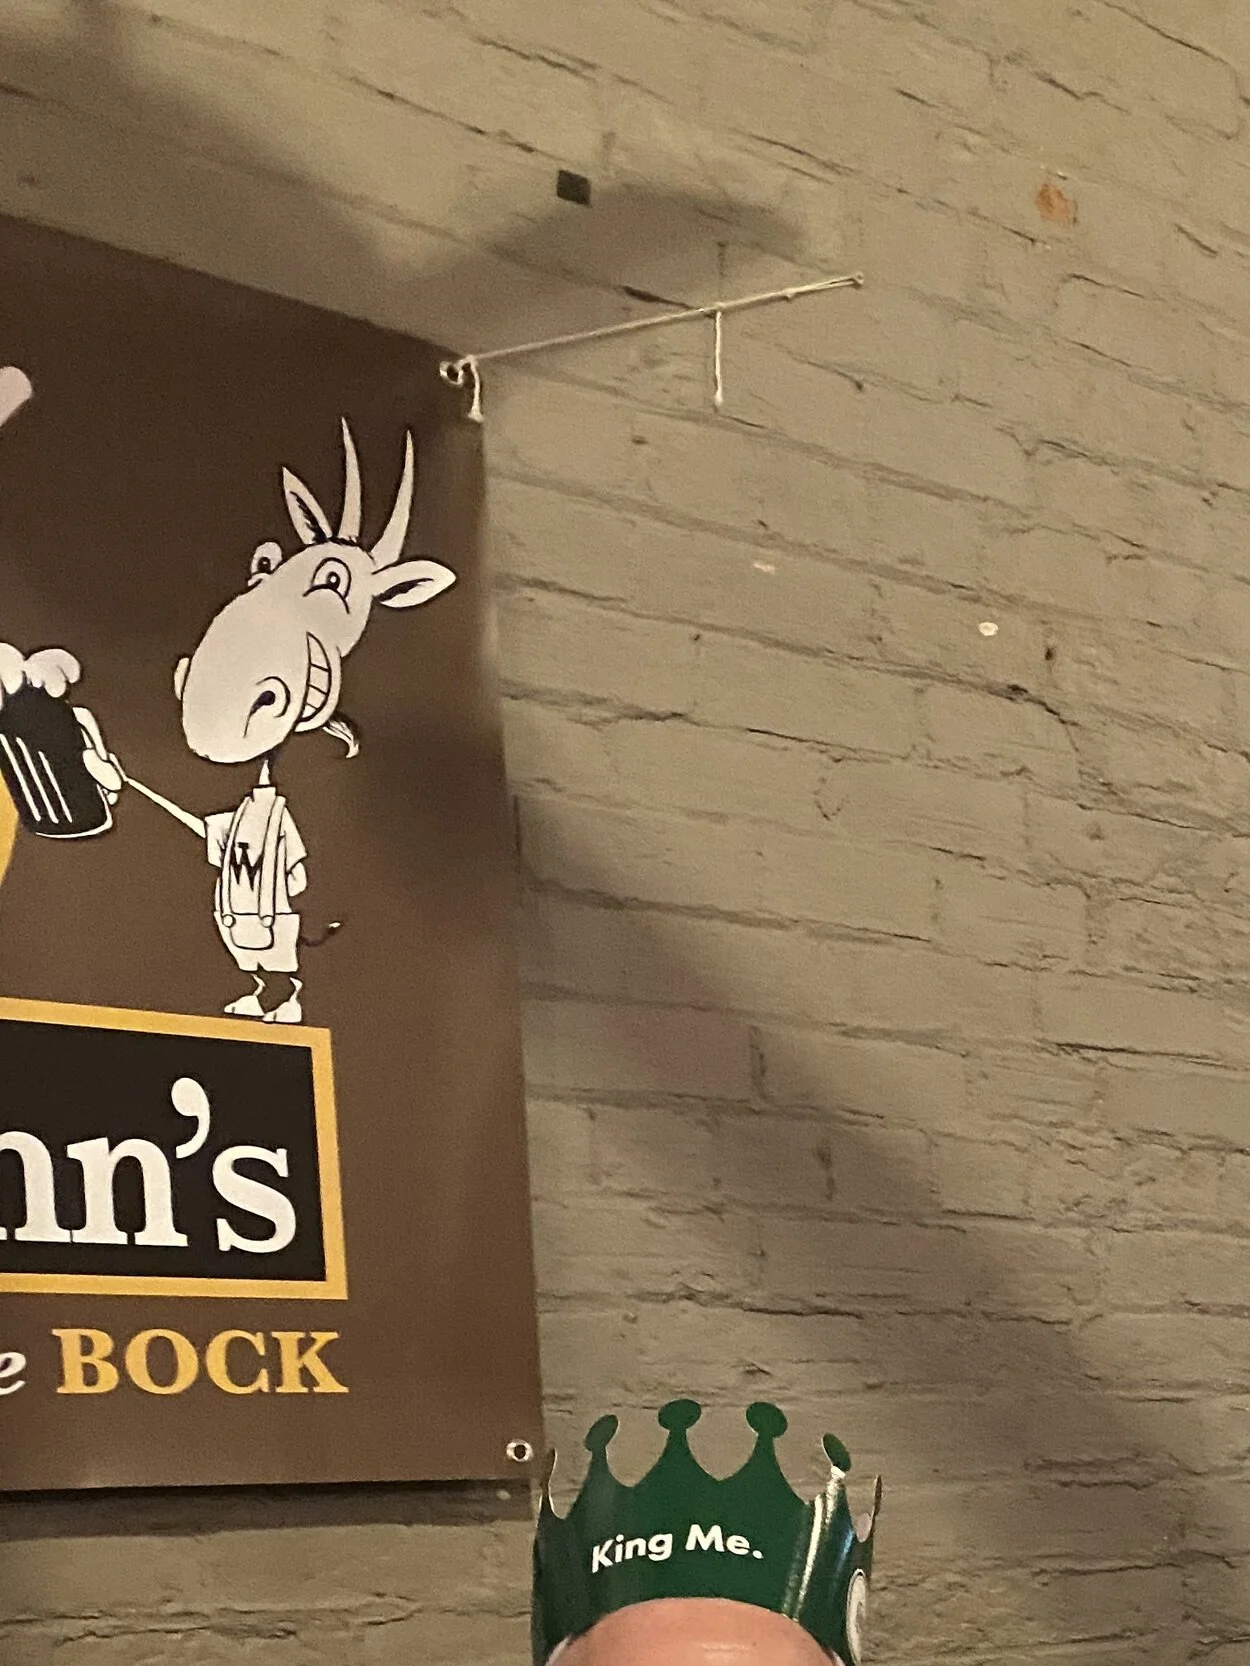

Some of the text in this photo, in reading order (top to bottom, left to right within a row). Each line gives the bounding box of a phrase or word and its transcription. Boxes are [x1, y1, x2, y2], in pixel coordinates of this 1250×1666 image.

[51, 1328, 350, 1396] BOCK
[592, 1523, 763, 1574] King Me.
